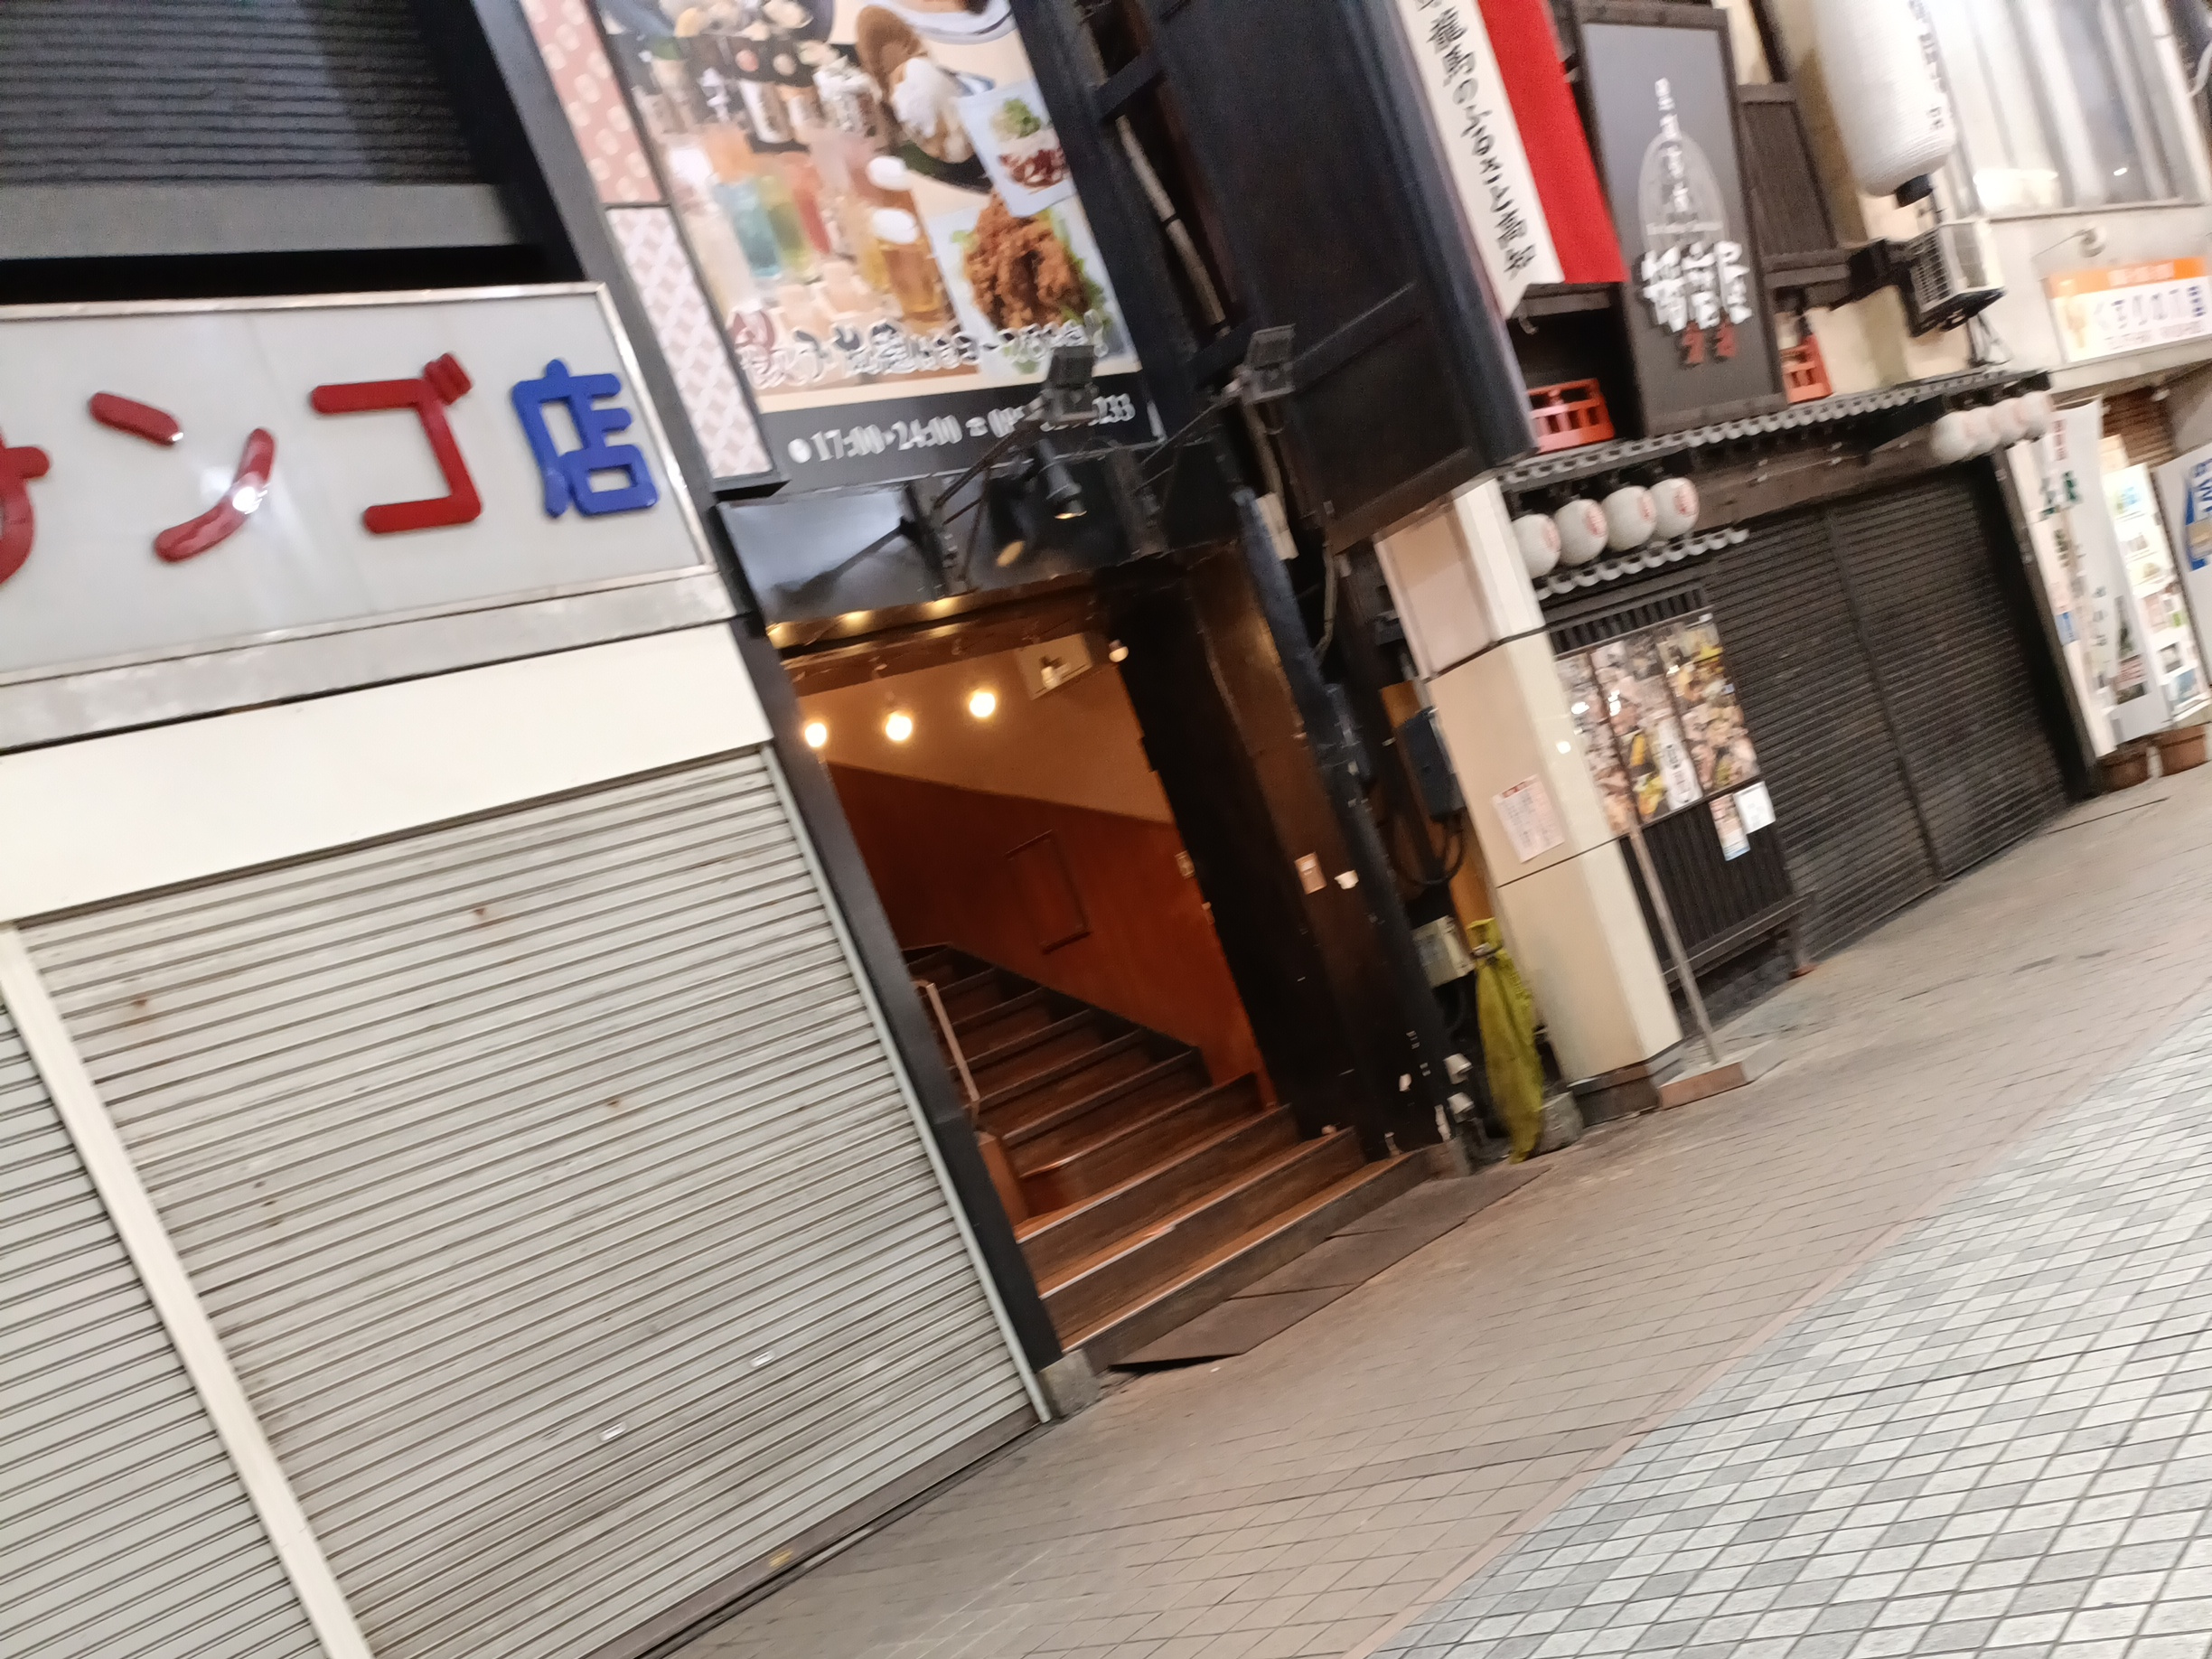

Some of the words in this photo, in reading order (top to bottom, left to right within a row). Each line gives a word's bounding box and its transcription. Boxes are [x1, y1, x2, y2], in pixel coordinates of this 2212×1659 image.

[1416, 0, 1538, 281] 龍馬のふるさと高知
